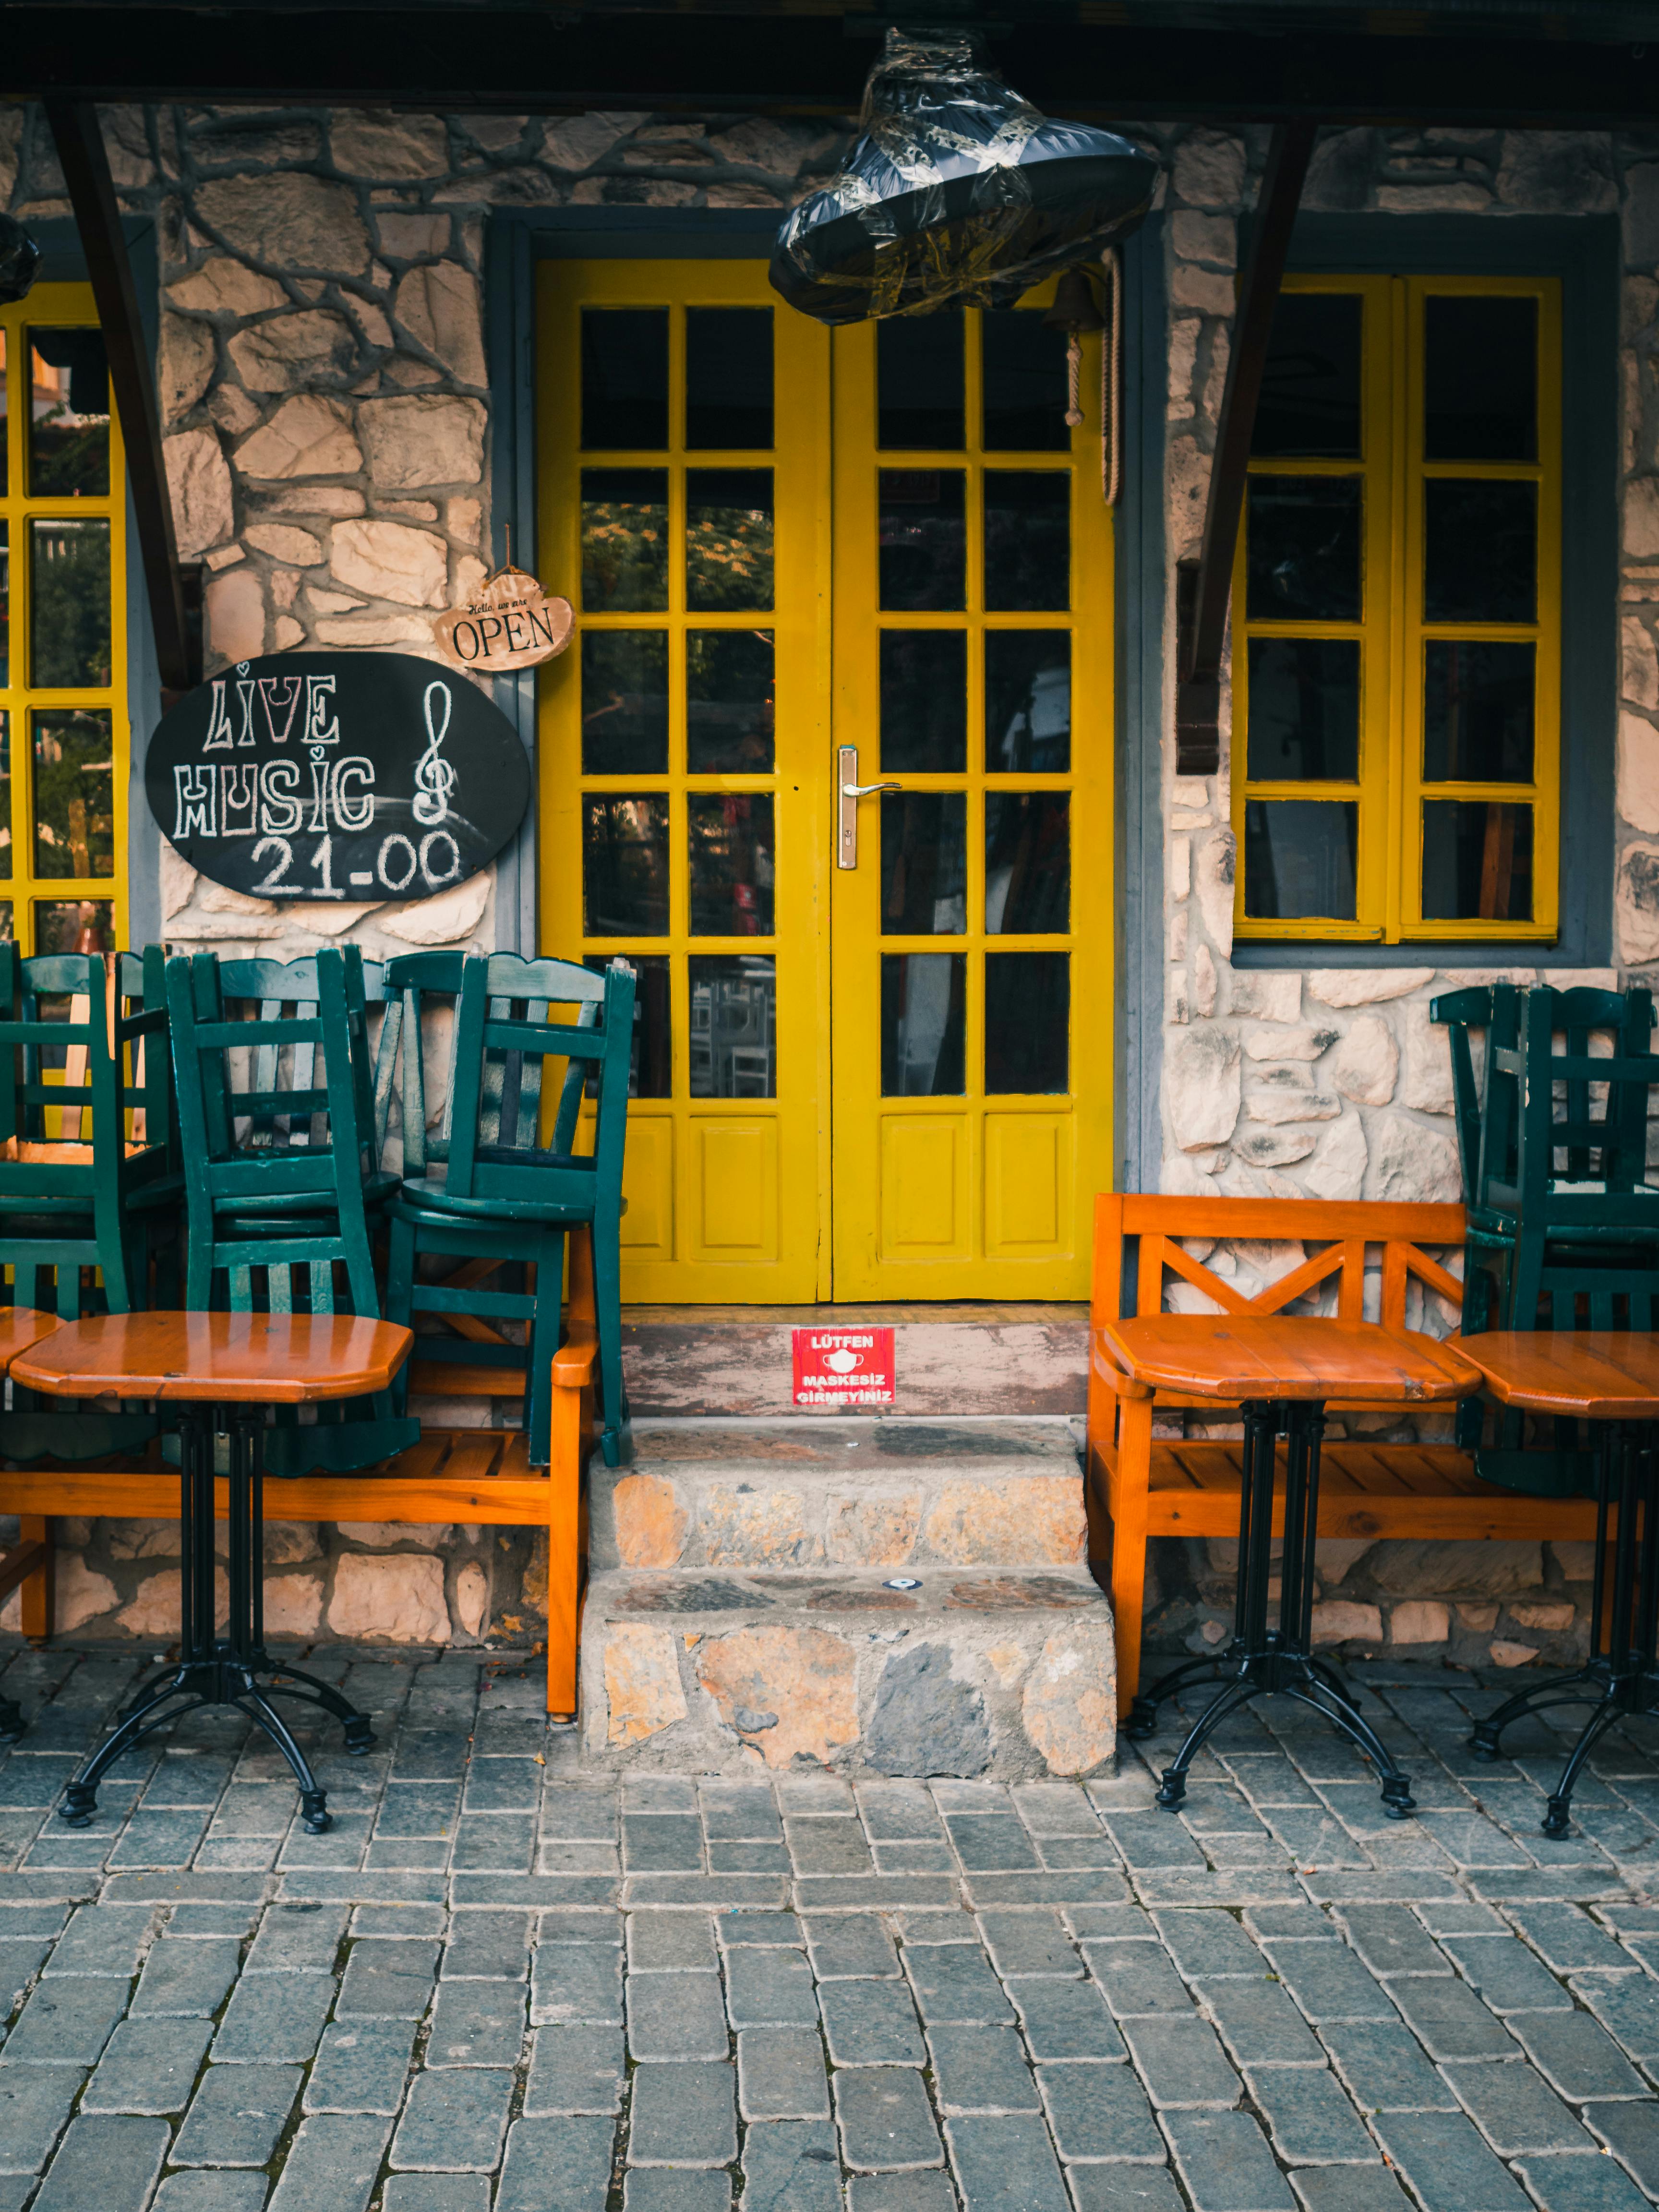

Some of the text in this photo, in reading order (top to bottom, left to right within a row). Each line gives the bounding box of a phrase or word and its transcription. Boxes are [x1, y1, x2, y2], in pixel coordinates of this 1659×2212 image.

[512, 599, 527, 607] are
[453, 607, 554, 660] OPEN
[251, 830, 460, 899] 21-00
[812, 1334, 874, 1348] LÜTFEN
[804, 1373, 886, 1386] MASKESİZ
[797, 1389, 892, 1404] GİRMEYİNİZ
